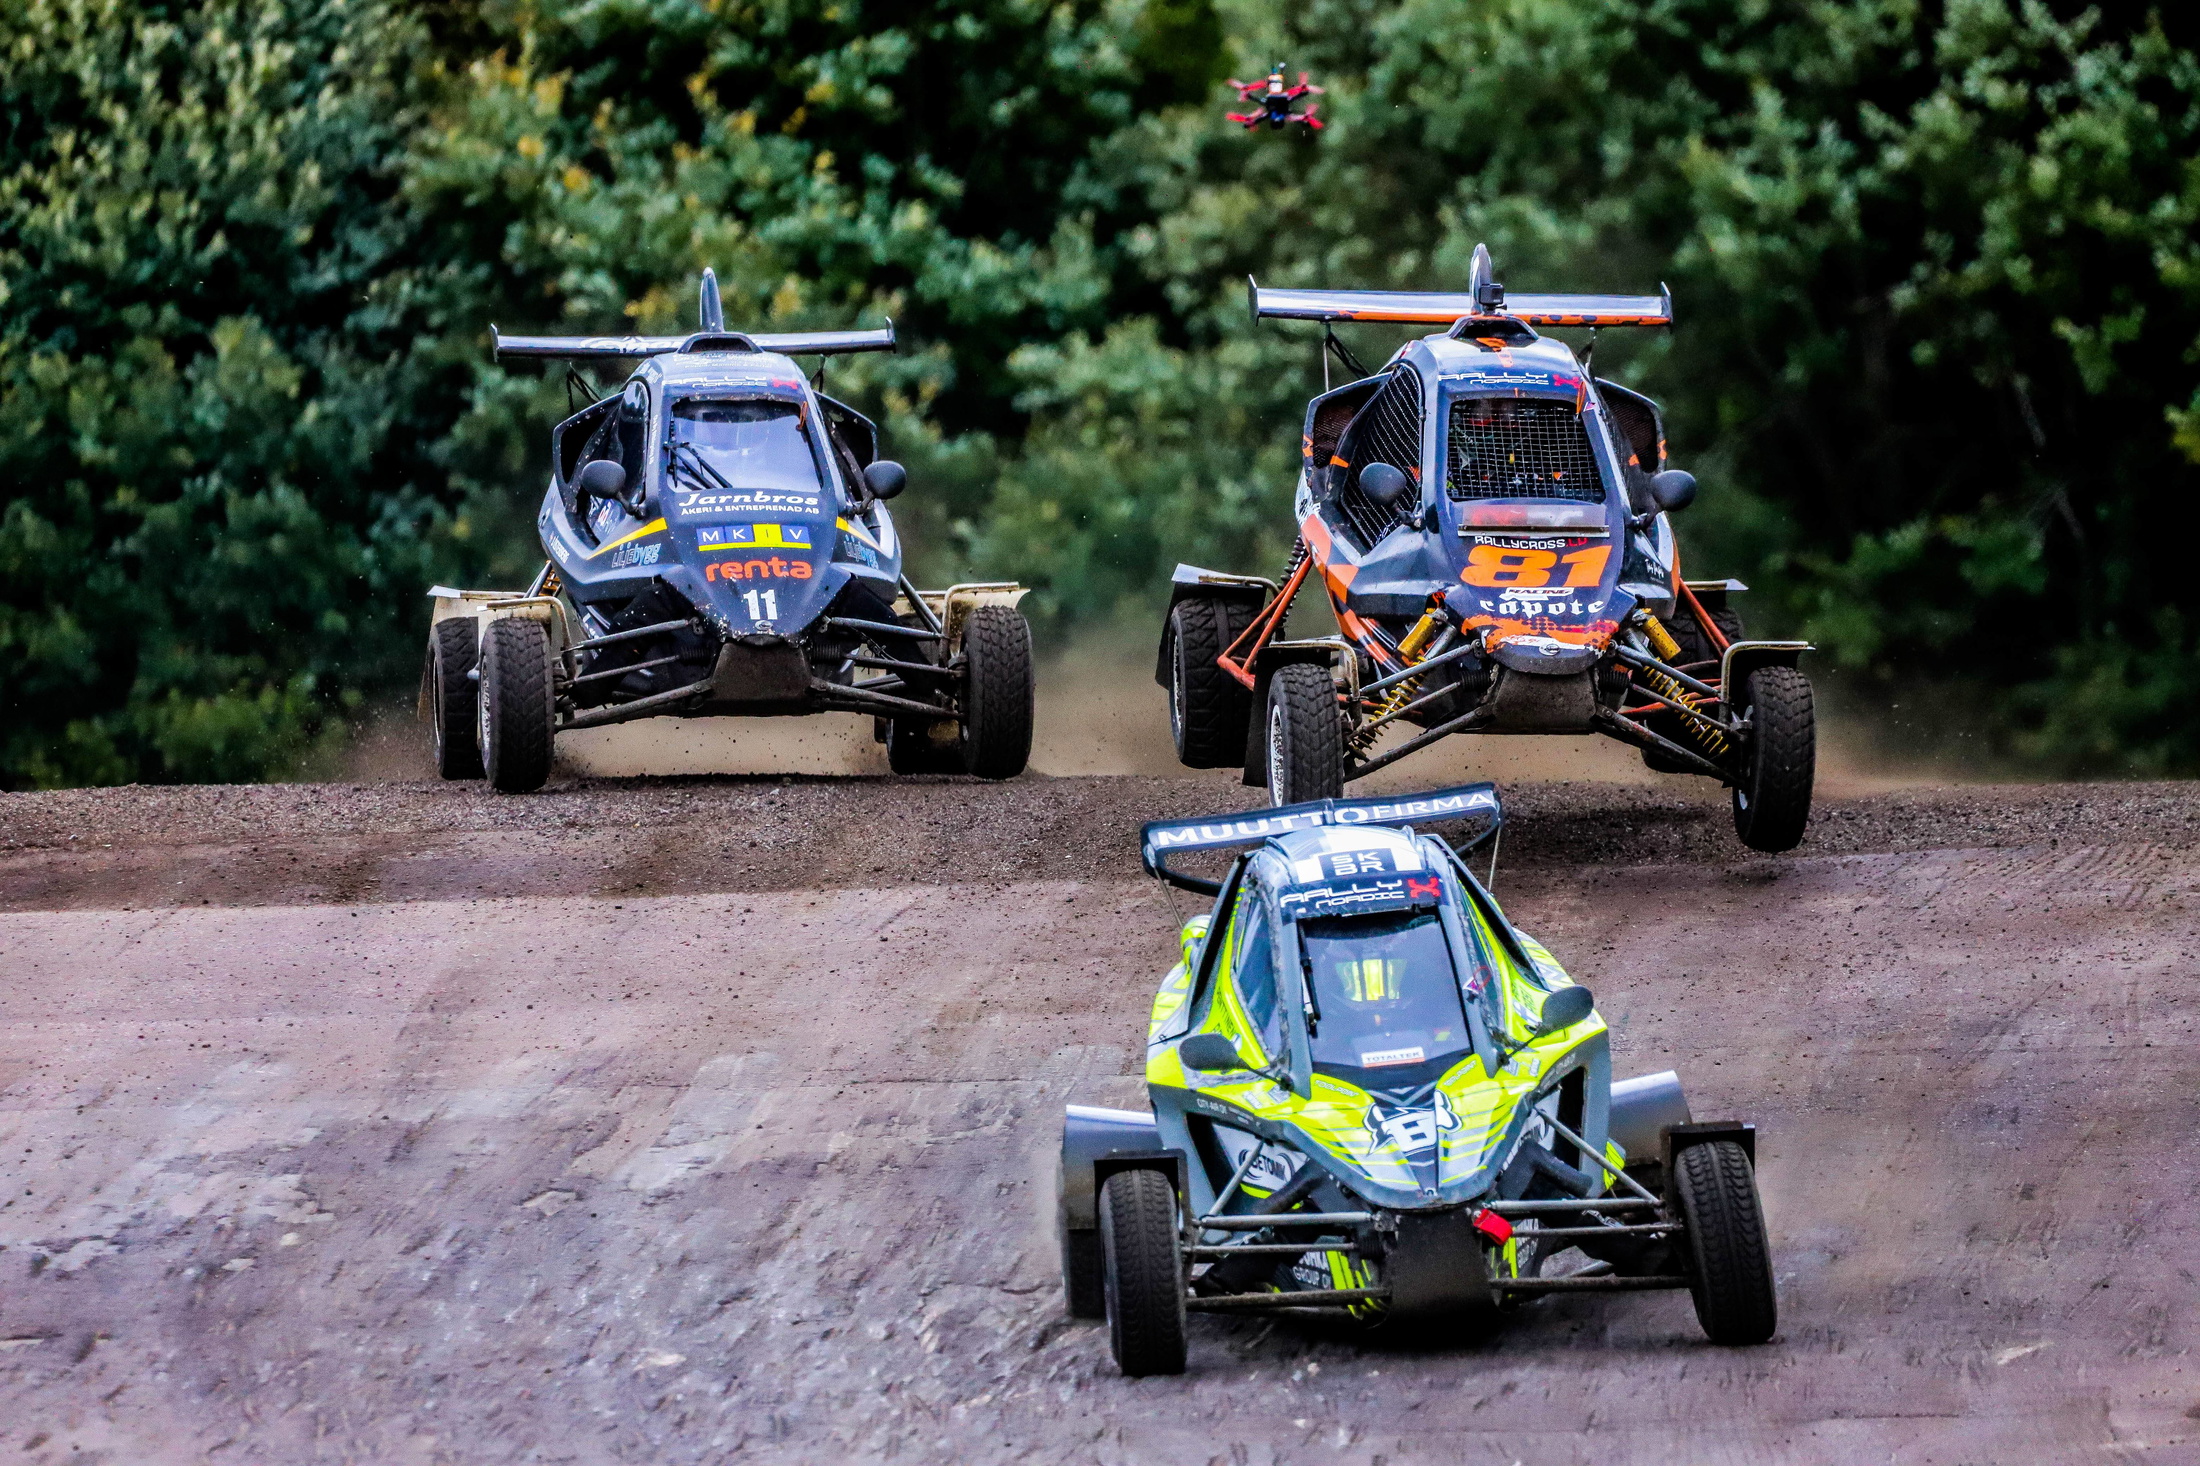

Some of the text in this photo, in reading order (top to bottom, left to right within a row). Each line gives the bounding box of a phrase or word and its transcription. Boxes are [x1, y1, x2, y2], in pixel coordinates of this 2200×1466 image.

[678, 491, 819, 507] Jarnbros
[725, 505, 803, 513] ENTREPRENAD
[804, 507, 820, 515] AB
[705, 556, 813, 582] renta
[1460, 545, 1612, 587] 81
[743, 589, 778, 620] 11
[1157, 793, 1495, 846] MUUTTOFIRMA
[1315, 890, 1405, 909] NORDIC
